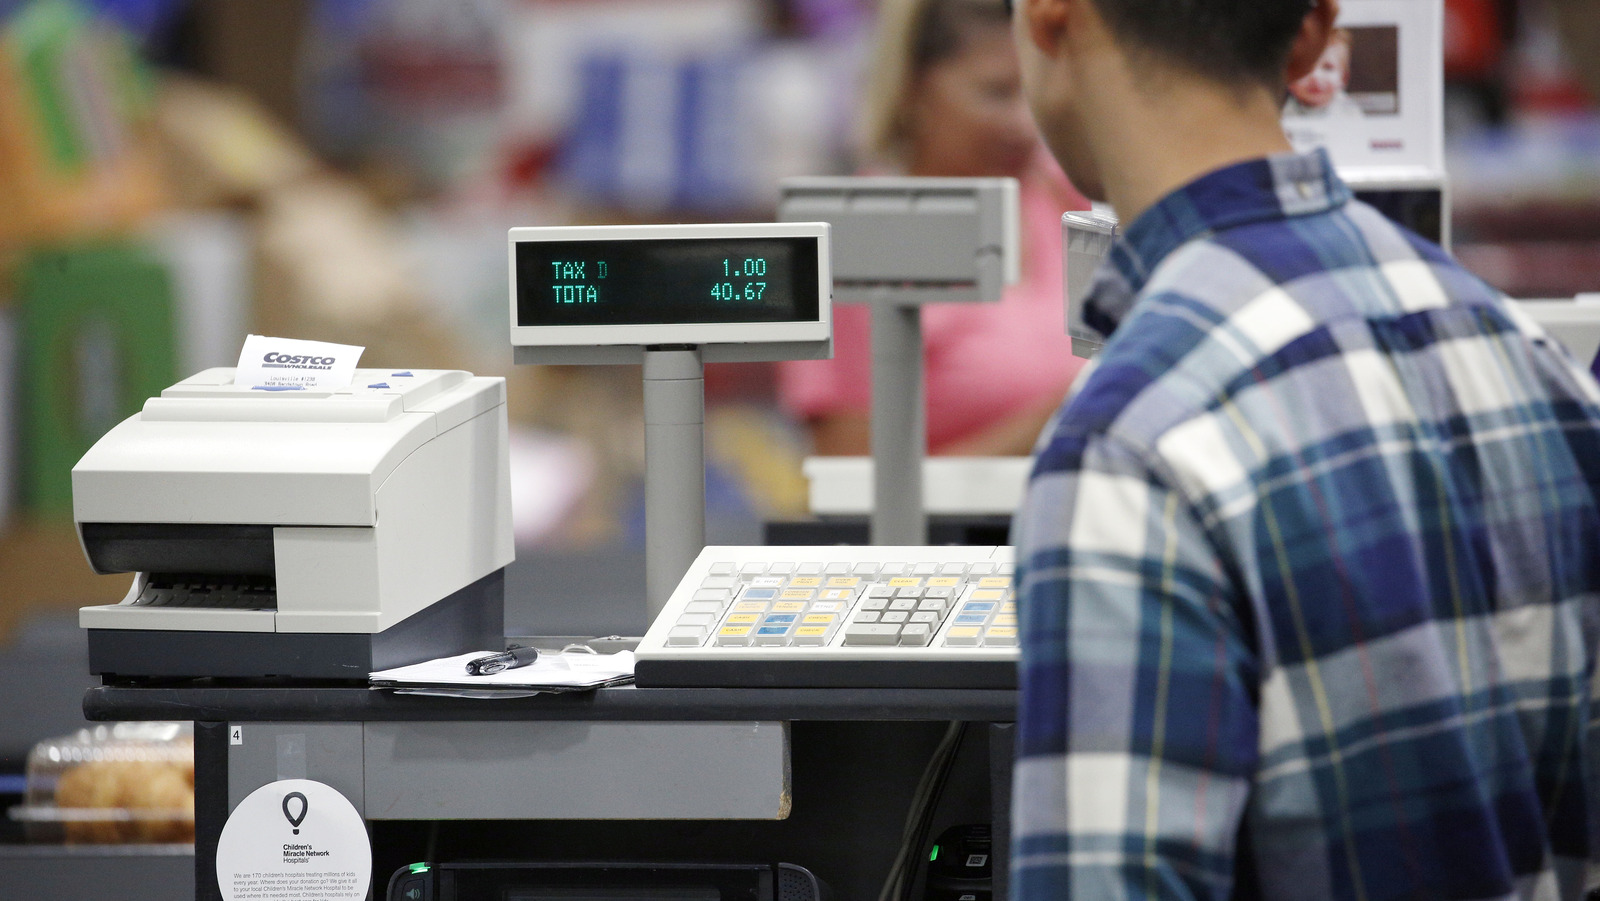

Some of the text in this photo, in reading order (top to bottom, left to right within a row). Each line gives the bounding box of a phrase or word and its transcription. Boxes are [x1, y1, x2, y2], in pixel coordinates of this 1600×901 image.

[551, 258, 766, 279] TAX D 1.00
[710, 283, 766, 301] 40.67
[263, 352, 335, 365] COSTCO
[233, 730, 239, 740] 4
